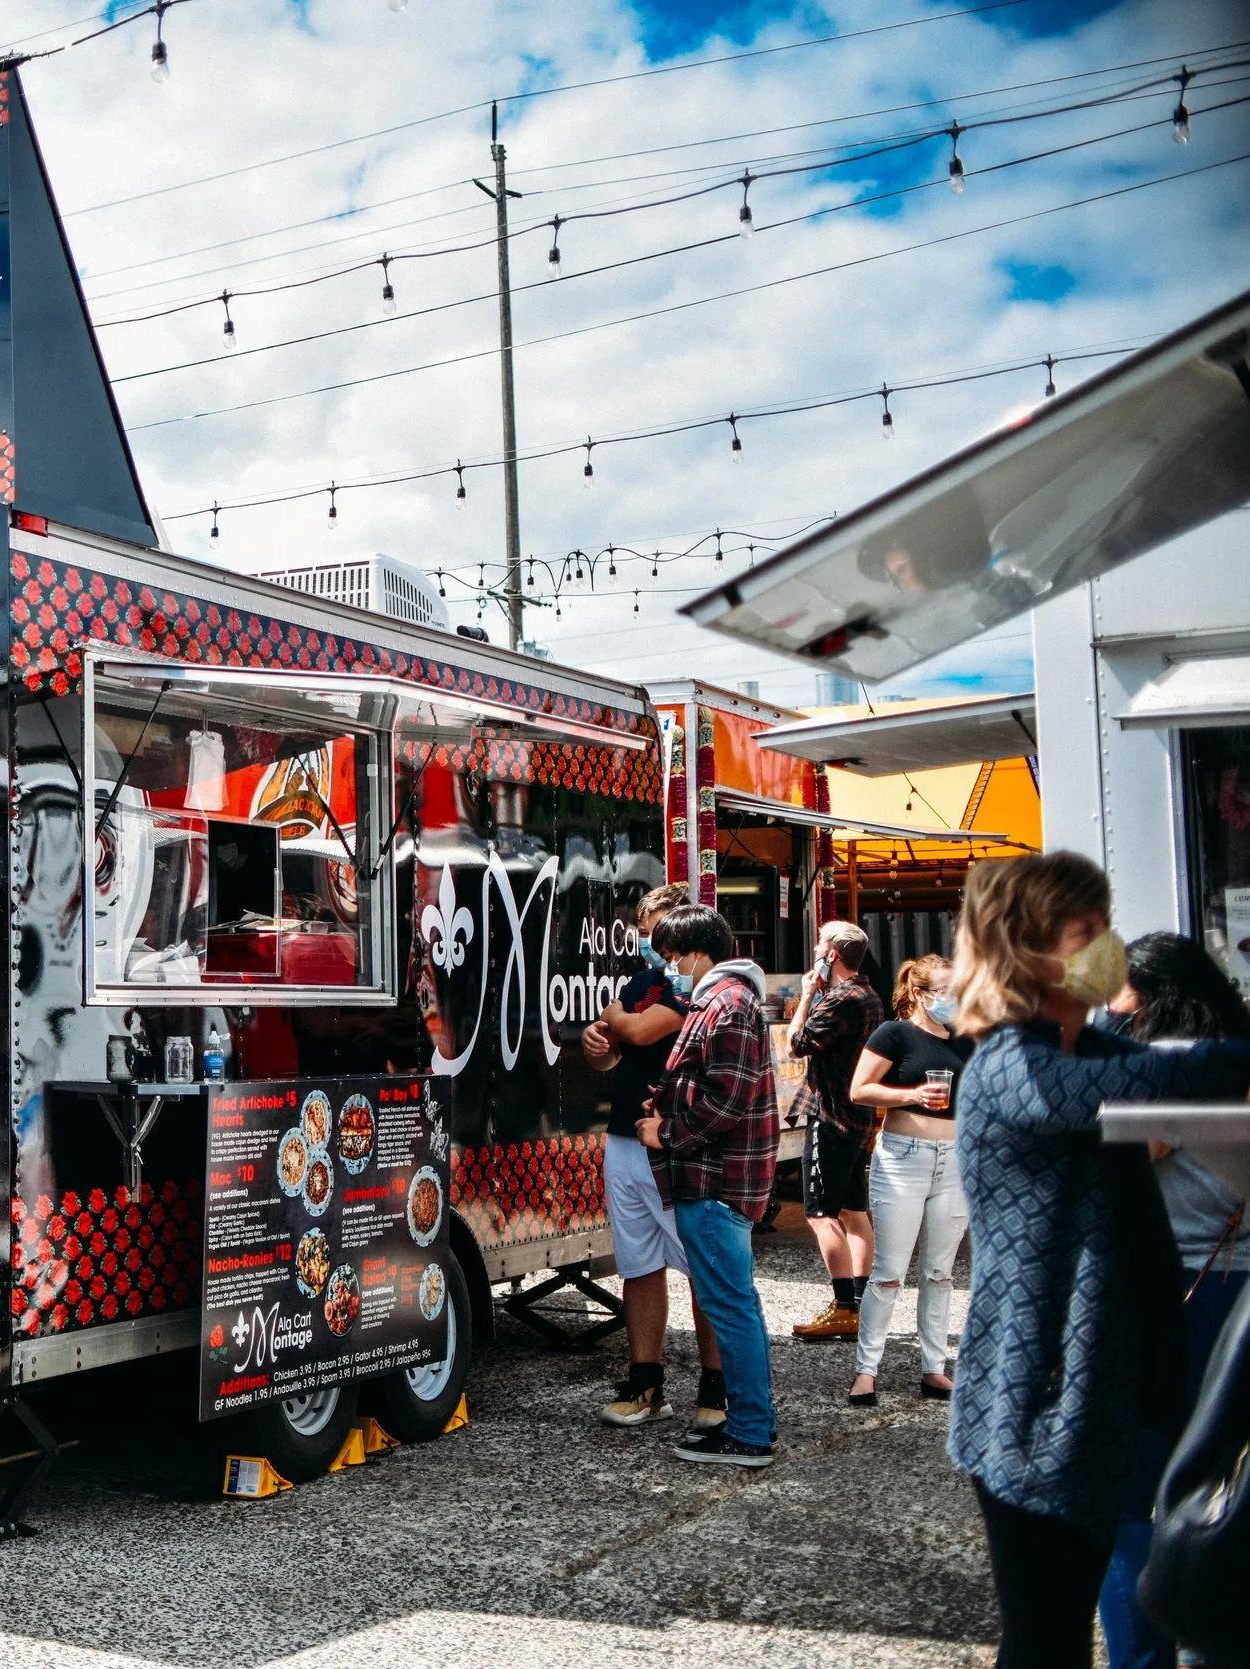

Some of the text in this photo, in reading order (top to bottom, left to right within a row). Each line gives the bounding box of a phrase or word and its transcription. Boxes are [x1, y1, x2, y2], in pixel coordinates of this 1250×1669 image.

[579, 917, 606, 955] Ala
[213, 1090, 296, 1111] Fried Artichoke $5
[393, 1090, 407, 1103] Boy
[213, 1113, 244, 1127] Hearts
[210, 1165, 254, 1185] Mac $10
[342, 1186, 389, 1202] Jambalaya
[209, 1243, 292, 1273] Nacho-Ronies $12
[278, 1311, 311, 1332] Ala Cart
[234, 1302, 312, 1373] Montage
[220, 1339, 418, 1395] Additions: Chicken 3.95 Bacon 2.95 Gator 4.95 Shrimp 4.95
[215, 1399, 224, 1410] GF
[226, 1394, 252, 1408] Noodles
[255, 1389, 267, 1400] 1.95
[273, 1381, 301, 1395] Andouille
[303, 1378, 315, 1388] 3.95
[321, 1372, 337, 1384] Spam
[339, 1368, 350, 1379] 3.95
[356, 1364, 378, 1375] Broccoli
[380, 1359, 390, 1370] 2.95
[396, 1352, 421, 1365] Jalapeño
